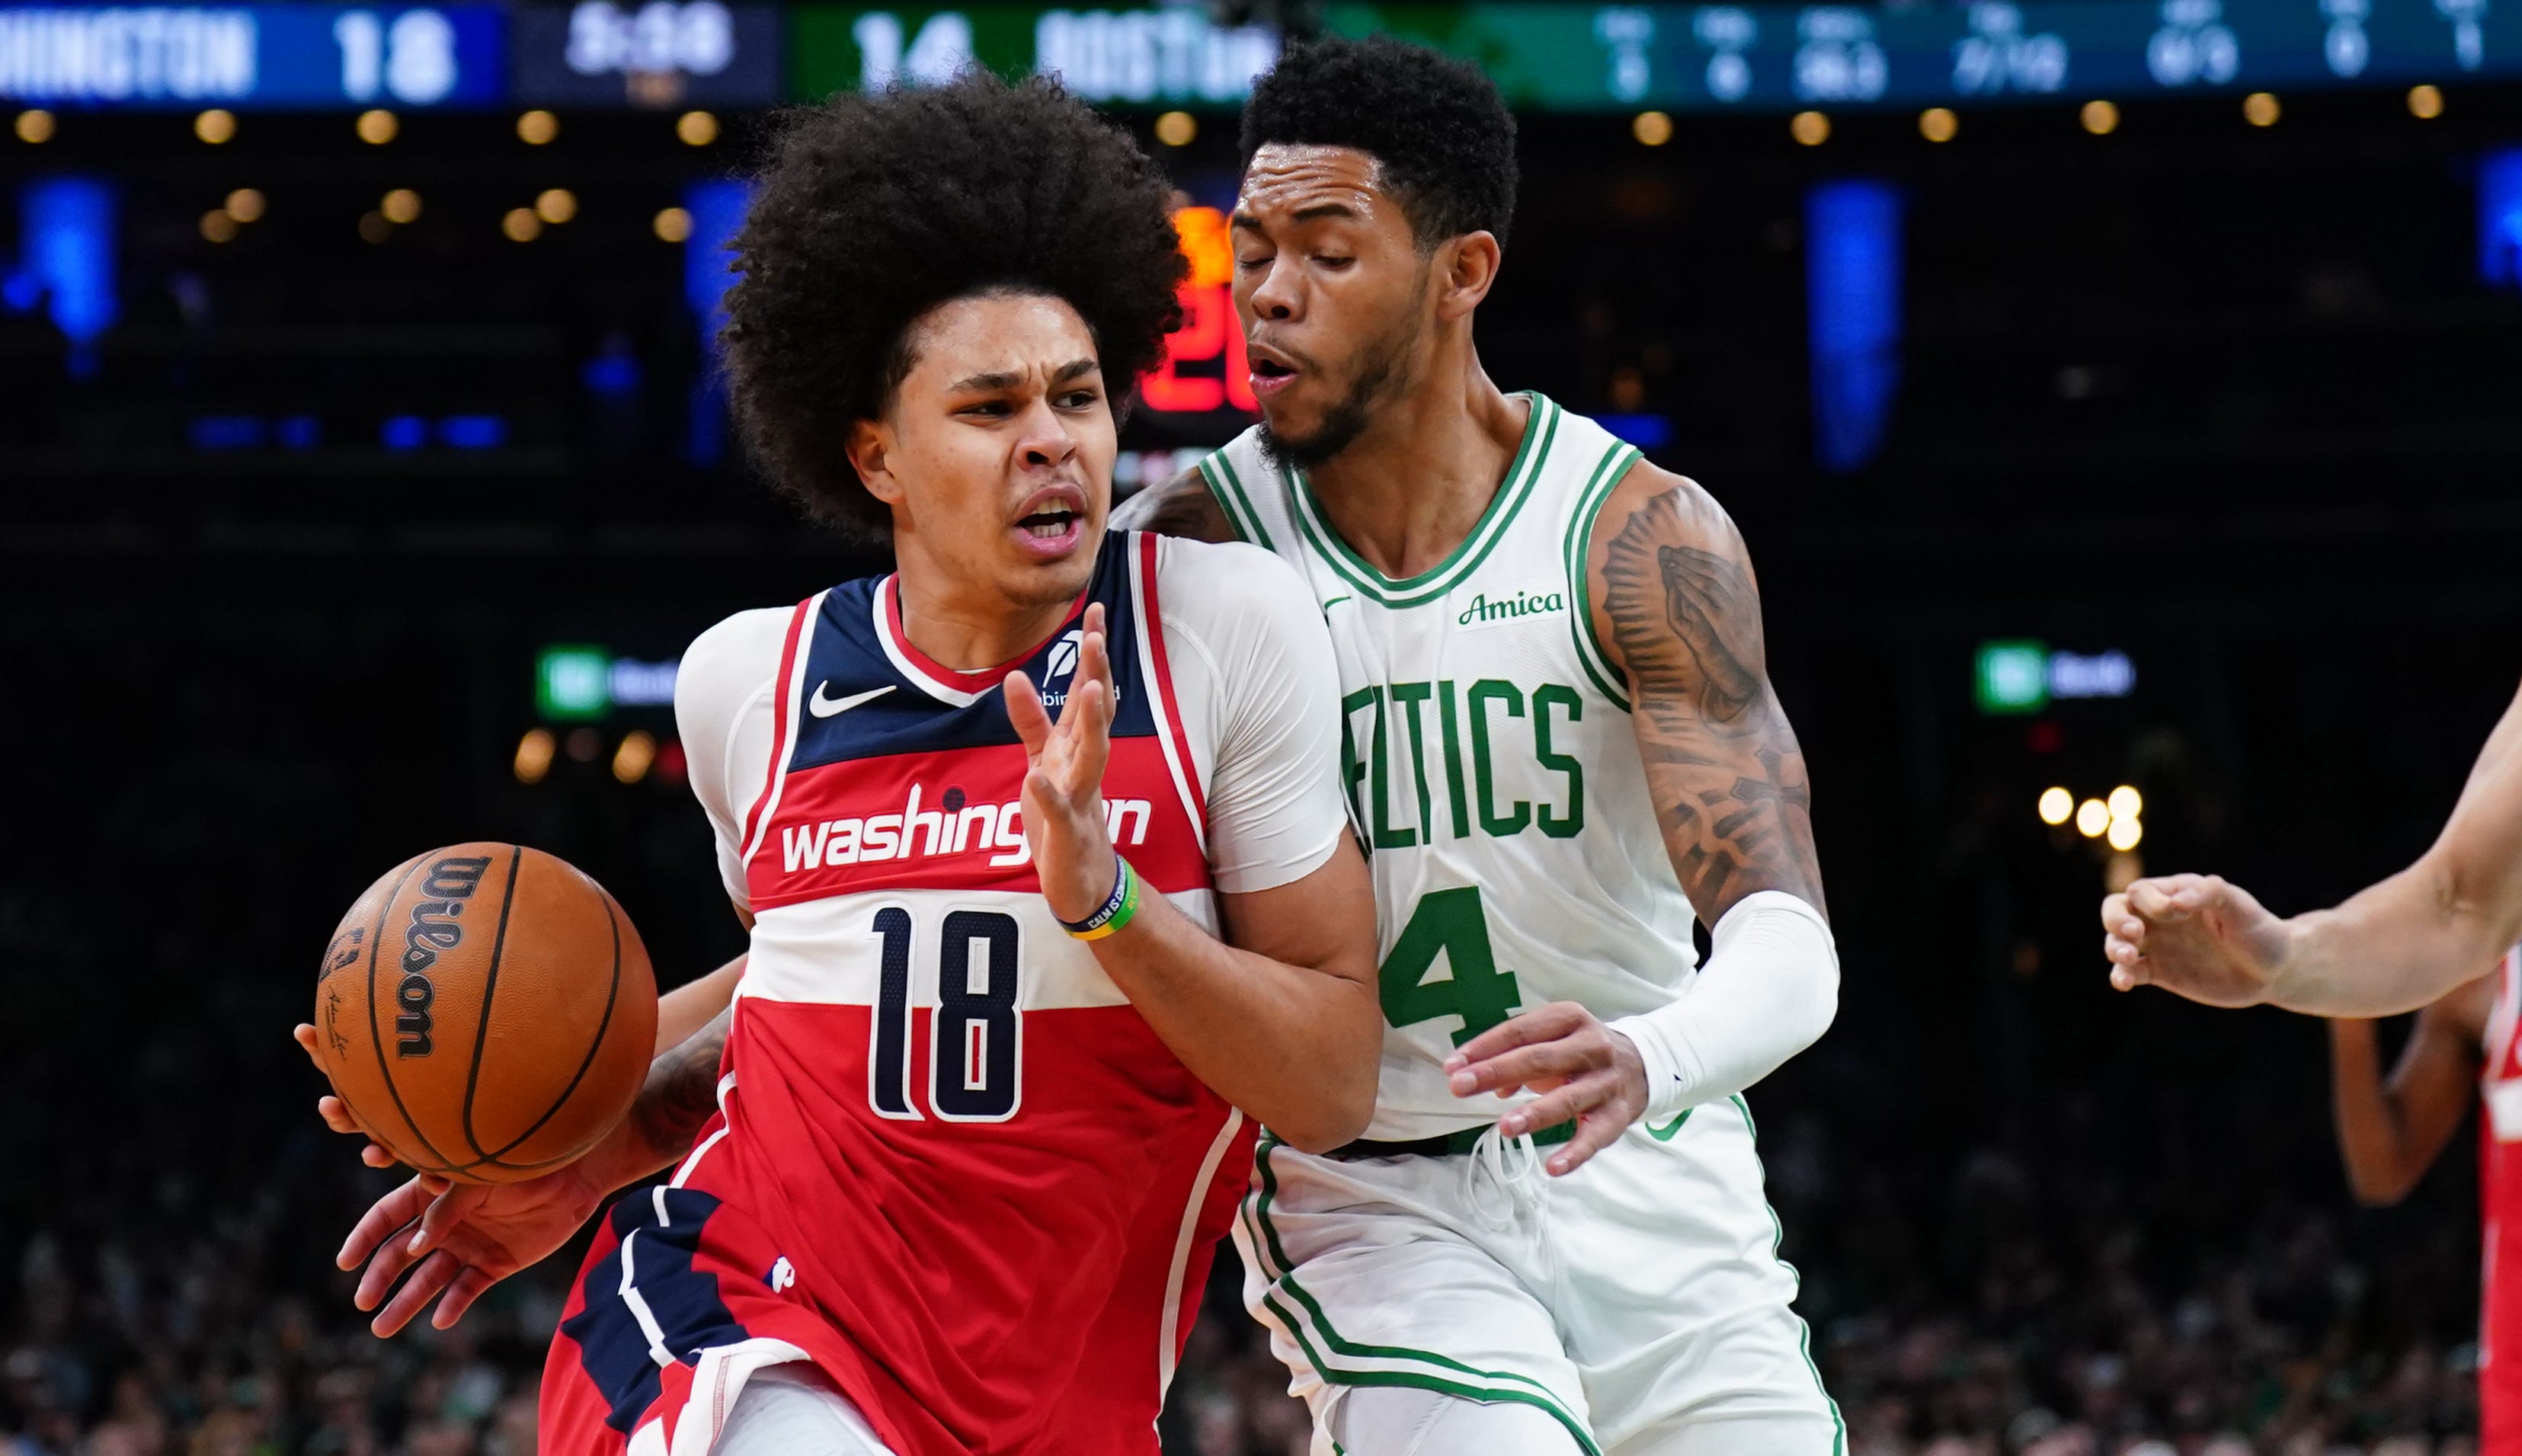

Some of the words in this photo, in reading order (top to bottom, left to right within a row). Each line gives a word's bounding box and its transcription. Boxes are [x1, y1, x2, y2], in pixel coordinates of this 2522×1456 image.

[334, 11, 456, 102] 18
[1458, 590, 1563, 626] Amica
[782, 782, 1152, 874] washingn
[1341, 678, 1585, 858] ELTICS
[396, 855, 494, 1061] Wilson
[868, 901, 1025, 1123] 18
[1378, 885, 1522, 1050] 4
